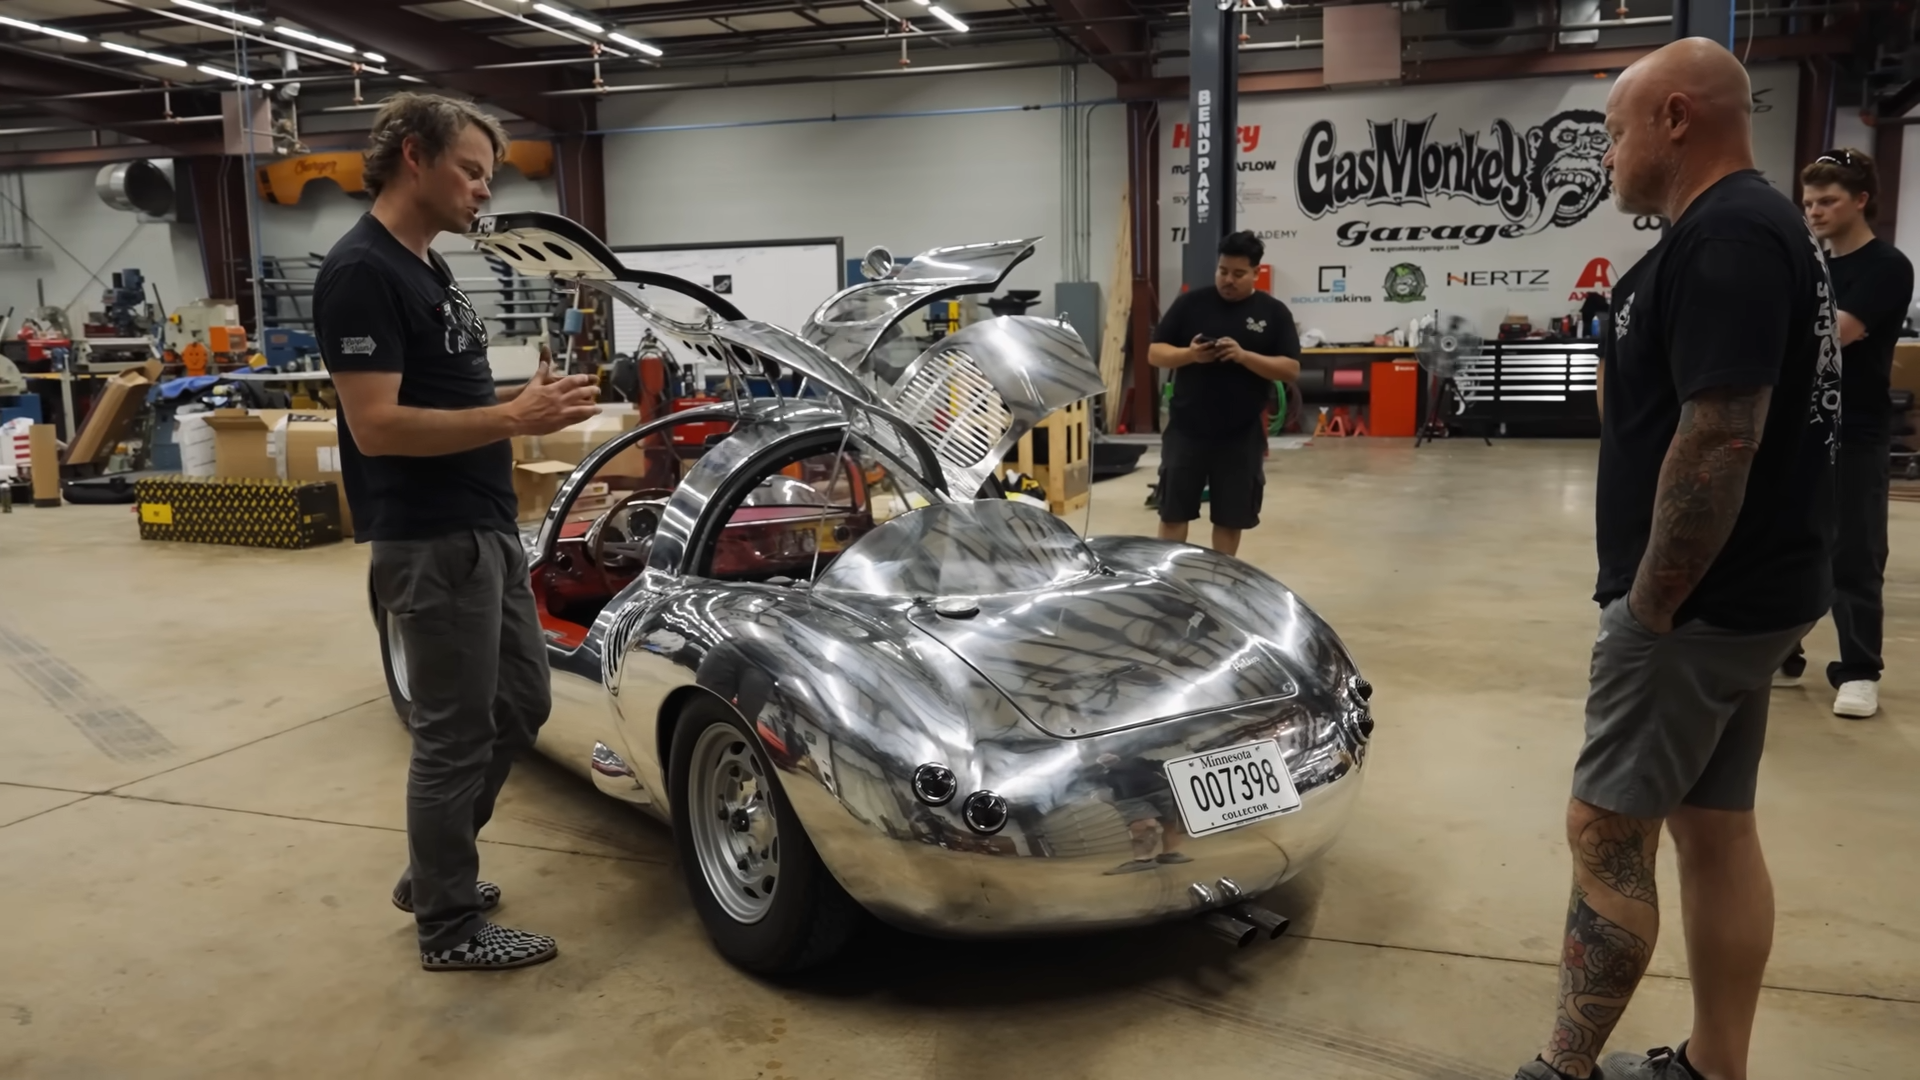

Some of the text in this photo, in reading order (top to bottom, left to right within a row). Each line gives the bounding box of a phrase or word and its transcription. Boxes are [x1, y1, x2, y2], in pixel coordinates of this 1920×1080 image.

[1197, 89, 1211, 204] BENDPAK
[1336, 220, 1525, 248] Garage
[1447, 269, 1550, 286] HERTZ
[1291, 294, 1372, 305] soundskins
[1200, 750, 1252, 769] Minnesota
[1190, 759, 1280, 812] 007398
[1222, 803, 1269, 820] COLLECTOR
